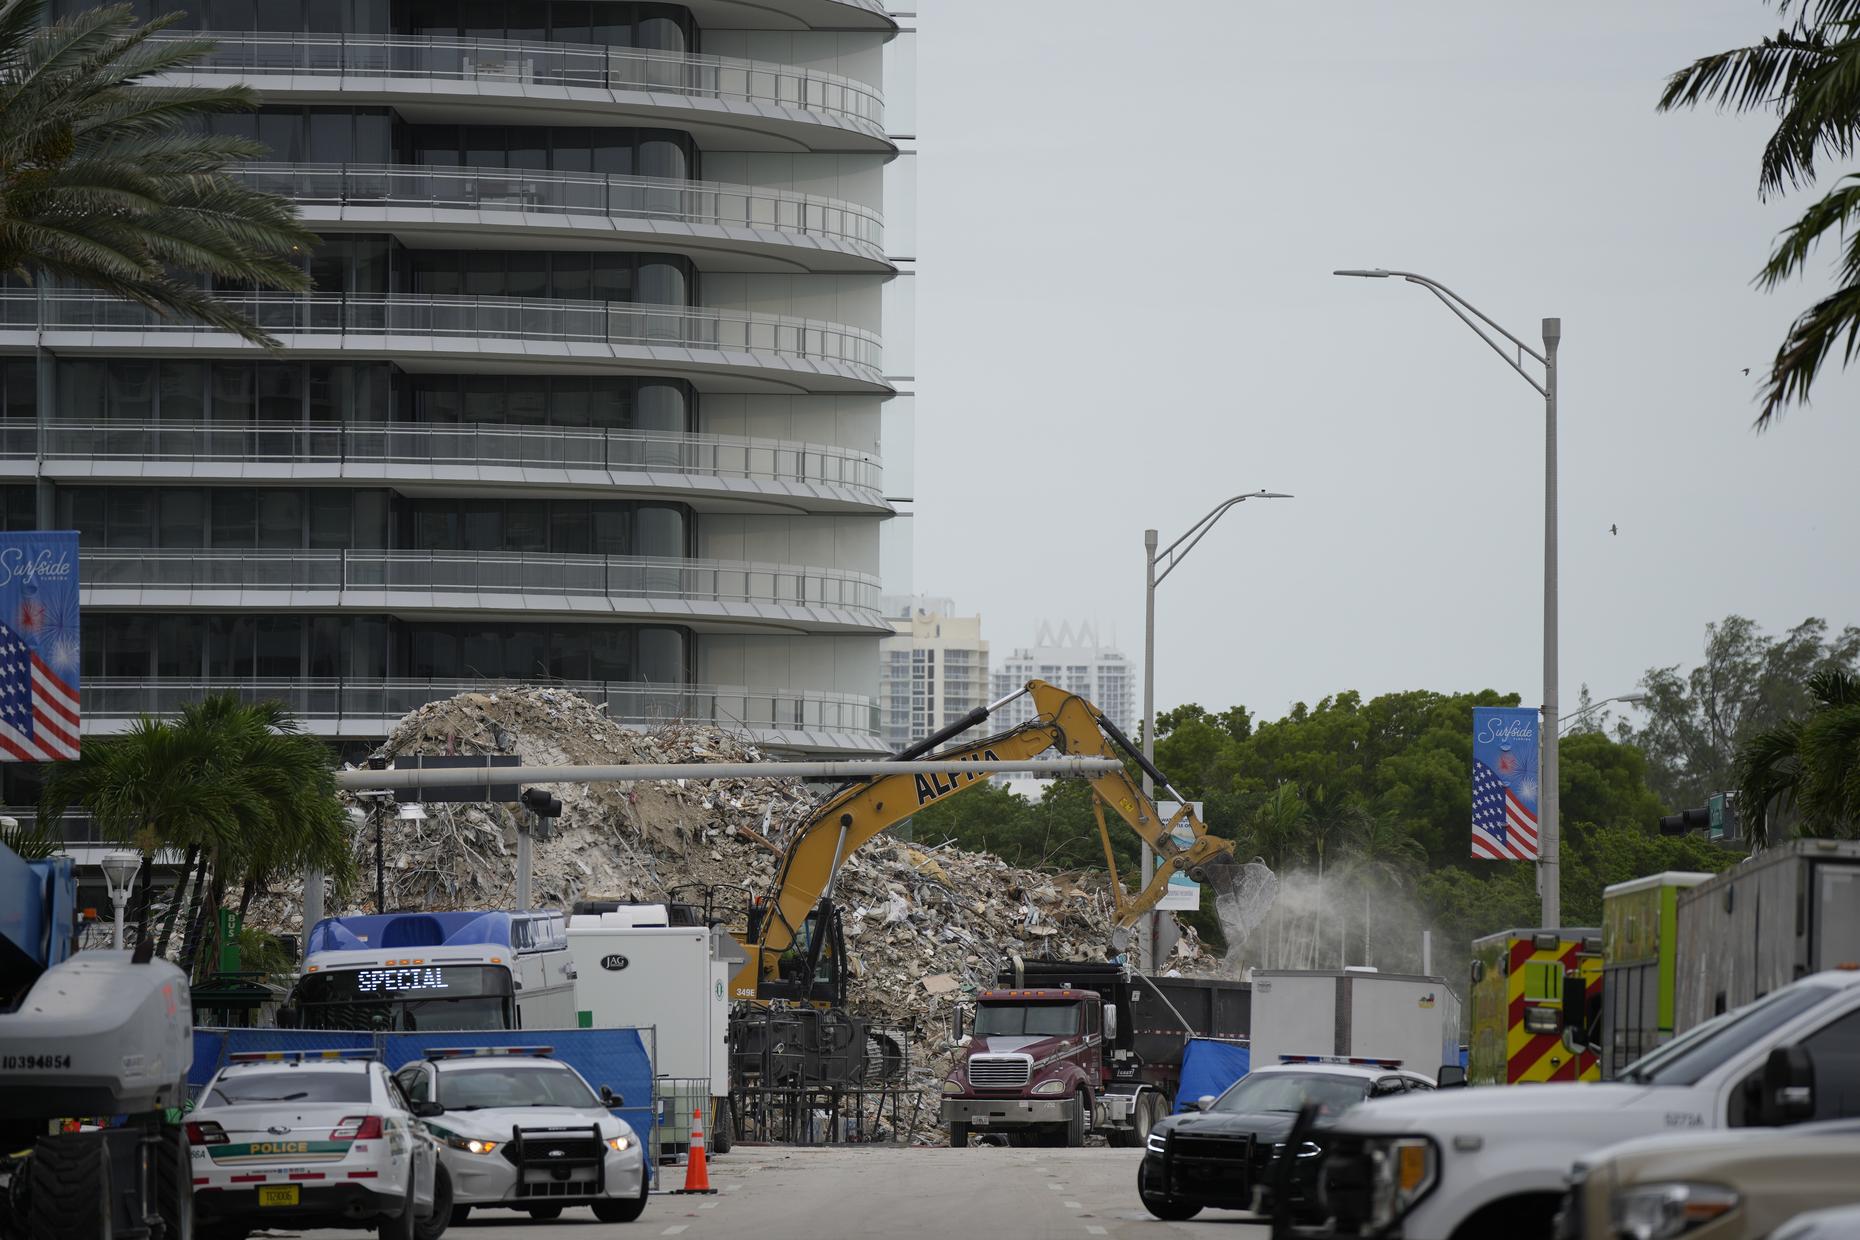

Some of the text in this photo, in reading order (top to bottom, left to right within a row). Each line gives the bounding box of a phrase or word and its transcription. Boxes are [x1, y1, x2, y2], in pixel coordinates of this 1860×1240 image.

[0, 547, 70, 587] Surfside
[1478, 717, 1533, 743] Surfside
[606, 956, 624, 969] JAG
[358, 968, 449, 991] SPECIAL
[736, 987, 755, 997] 349E
[250, 1142, 308, 1154] POLICE
